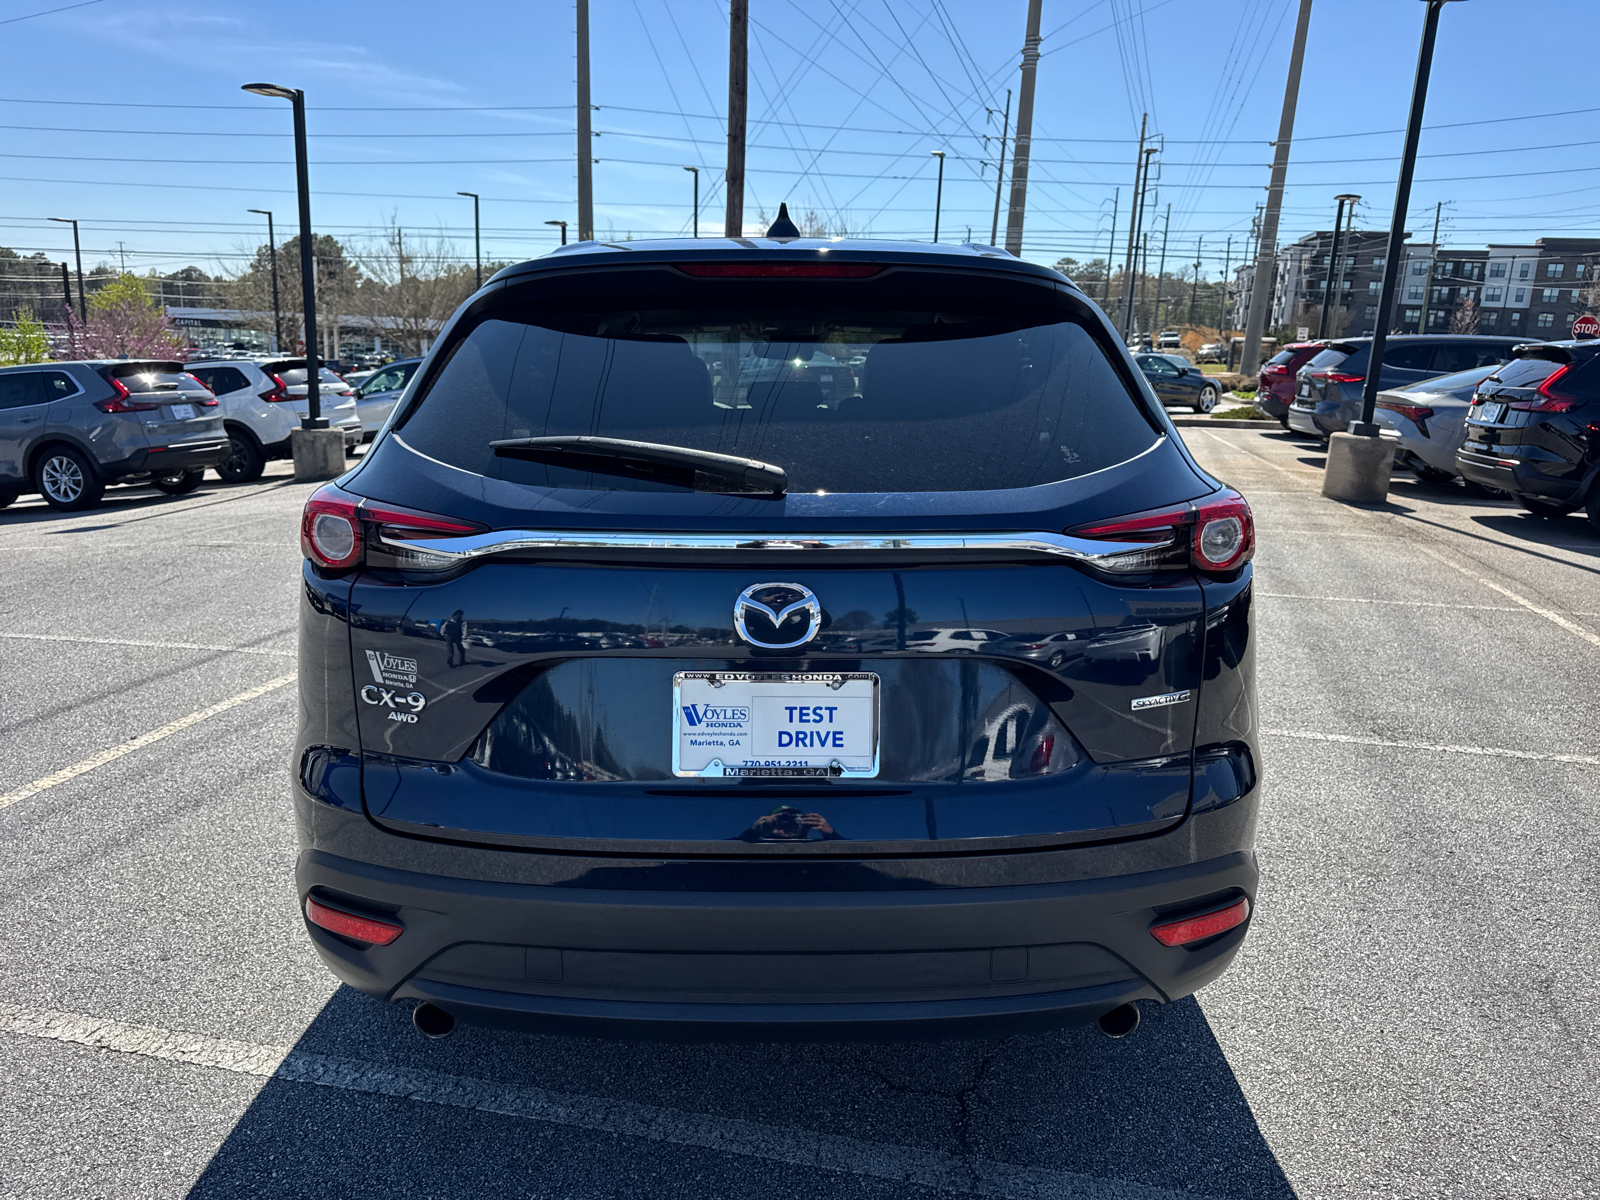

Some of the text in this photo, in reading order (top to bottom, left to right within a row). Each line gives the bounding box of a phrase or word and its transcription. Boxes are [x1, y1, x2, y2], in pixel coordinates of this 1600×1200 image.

[175, 318, 202, 326] CAPITAL
[1574, 323, 1598, 334] STOP
[375, 651, 416, 672] VOYLES
[382, 672, 408, 680] HONDA
[361, 685, 426, 711] CX-9
[388, 711, 418, 723] AWD
[690, 704, 747, 724] VOYLES
[784, 706, 838, 724] TEST
[689, 739, 726, 747] Marietta,
[777, 730, 845, 748] DRIVE
[725, 767, 798, 776] Marietta,
